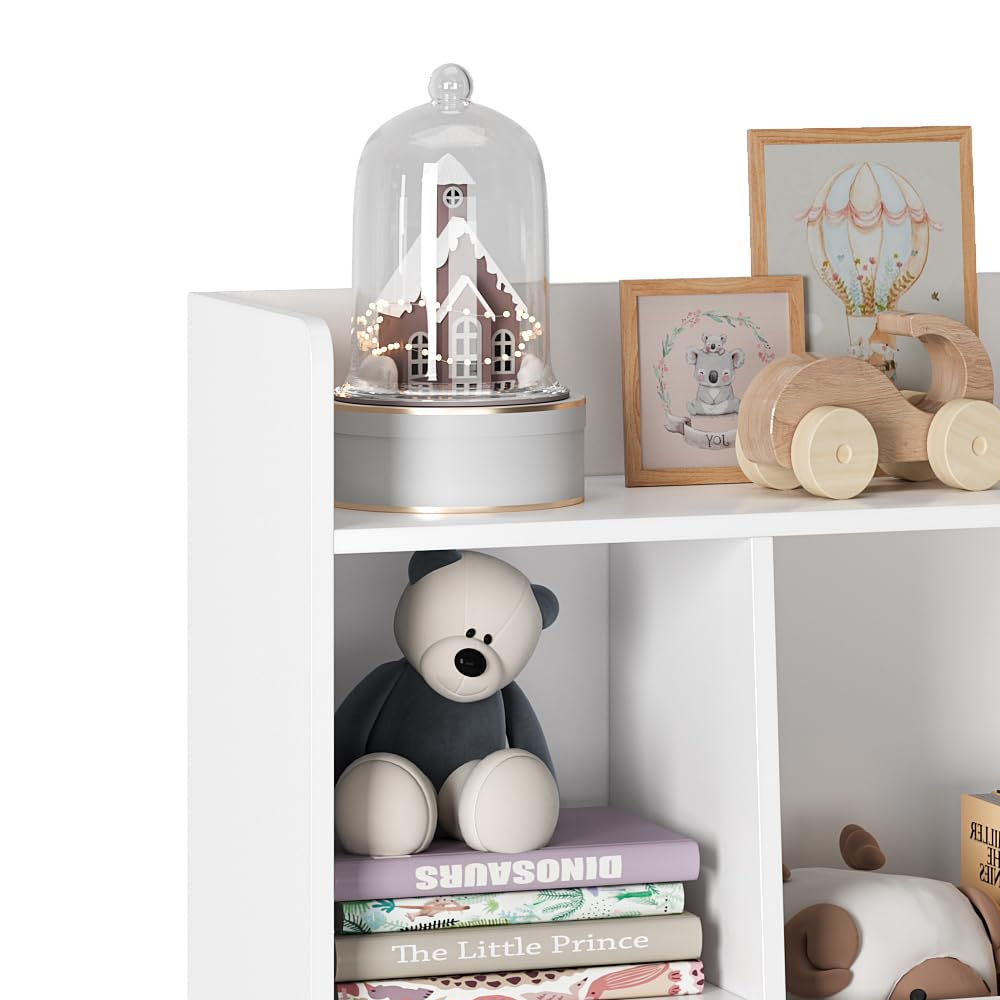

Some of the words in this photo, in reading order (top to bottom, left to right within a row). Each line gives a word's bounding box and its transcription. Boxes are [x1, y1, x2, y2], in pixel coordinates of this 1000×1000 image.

[414, 855, 623, 891] DINOSAURS
[391, 943, 448, 964] The
[457, 935, 542, 961] Little
[551, 932, 650, 955] Prince
